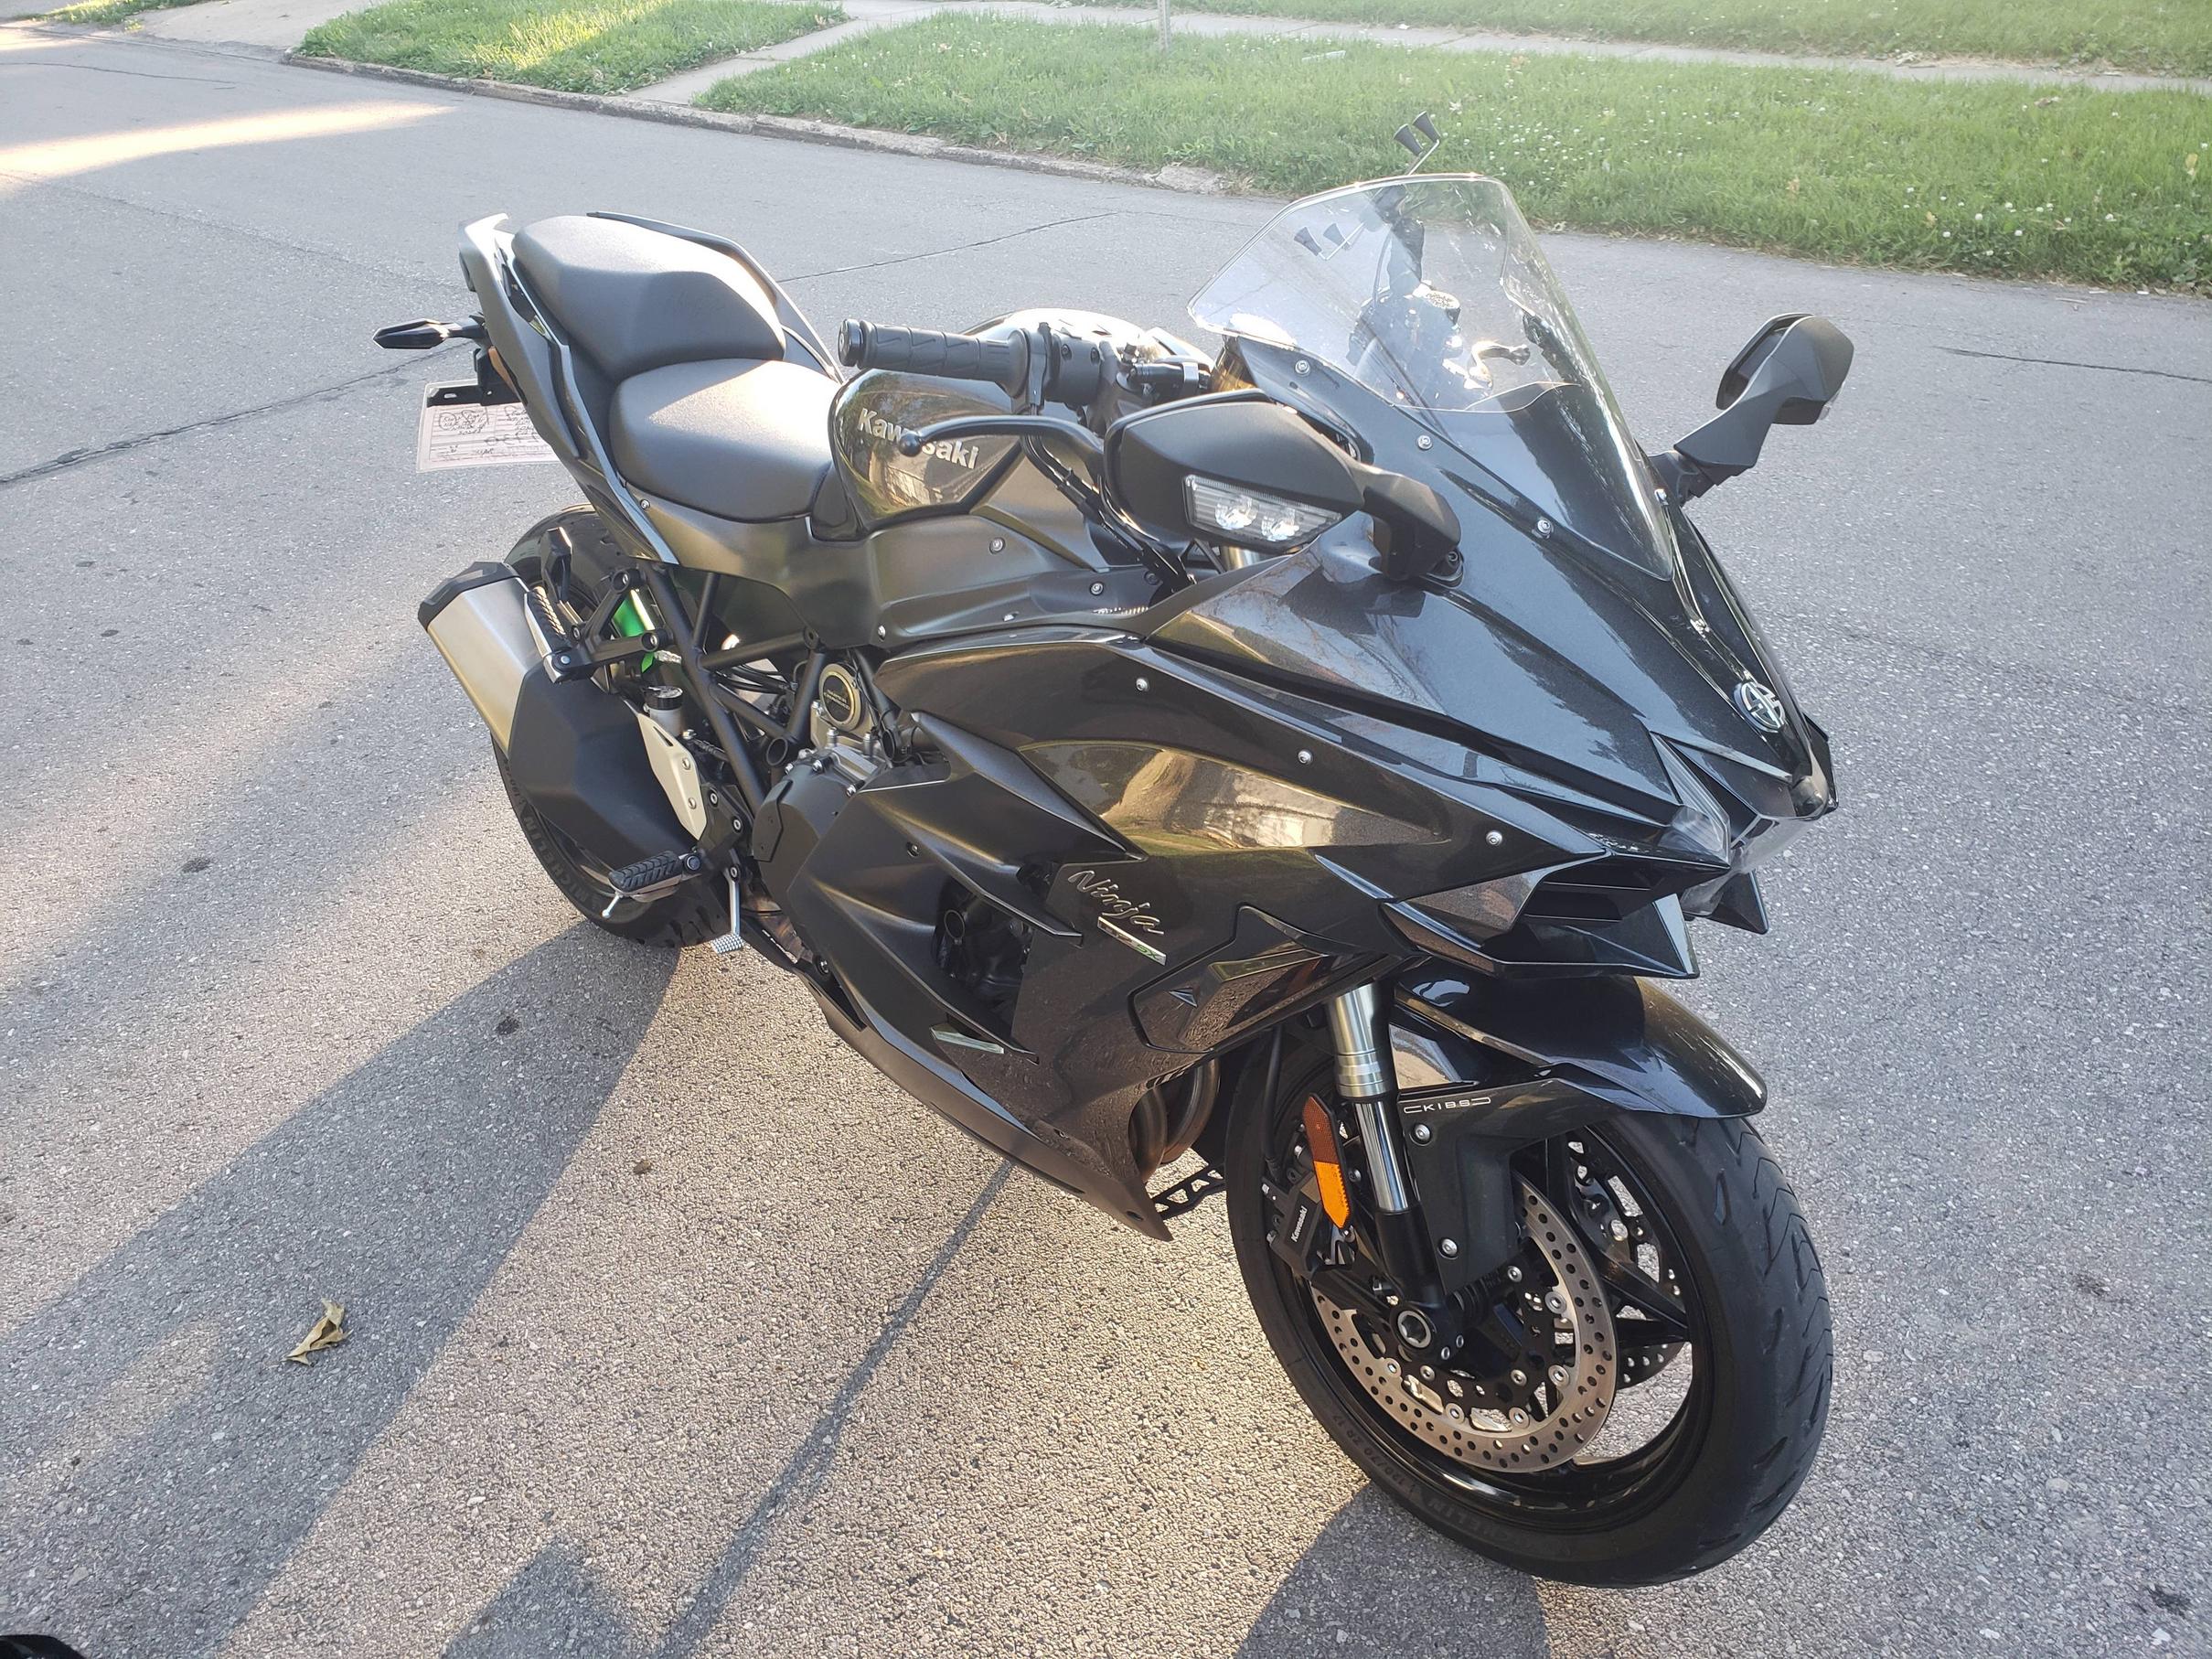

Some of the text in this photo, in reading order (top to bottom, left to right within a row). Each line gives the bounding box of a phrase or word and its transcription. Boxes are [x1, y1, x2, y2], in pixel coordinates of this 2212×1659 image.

[858, 408, 979, 469] Kawsaki
[523, 817, 590, 903] MICHELIN
[1068, 871, 1164, 935] Ninja
[1135, 943, 1159, 961] SX
[1423, 1099, 1471, 1112] KIBS
[1290, 1204, 1308, 1242] Kawasaki
[1345, 1429, 1363, 1446] ZR
[1363, 1447, 1404, 1486] 120/70
